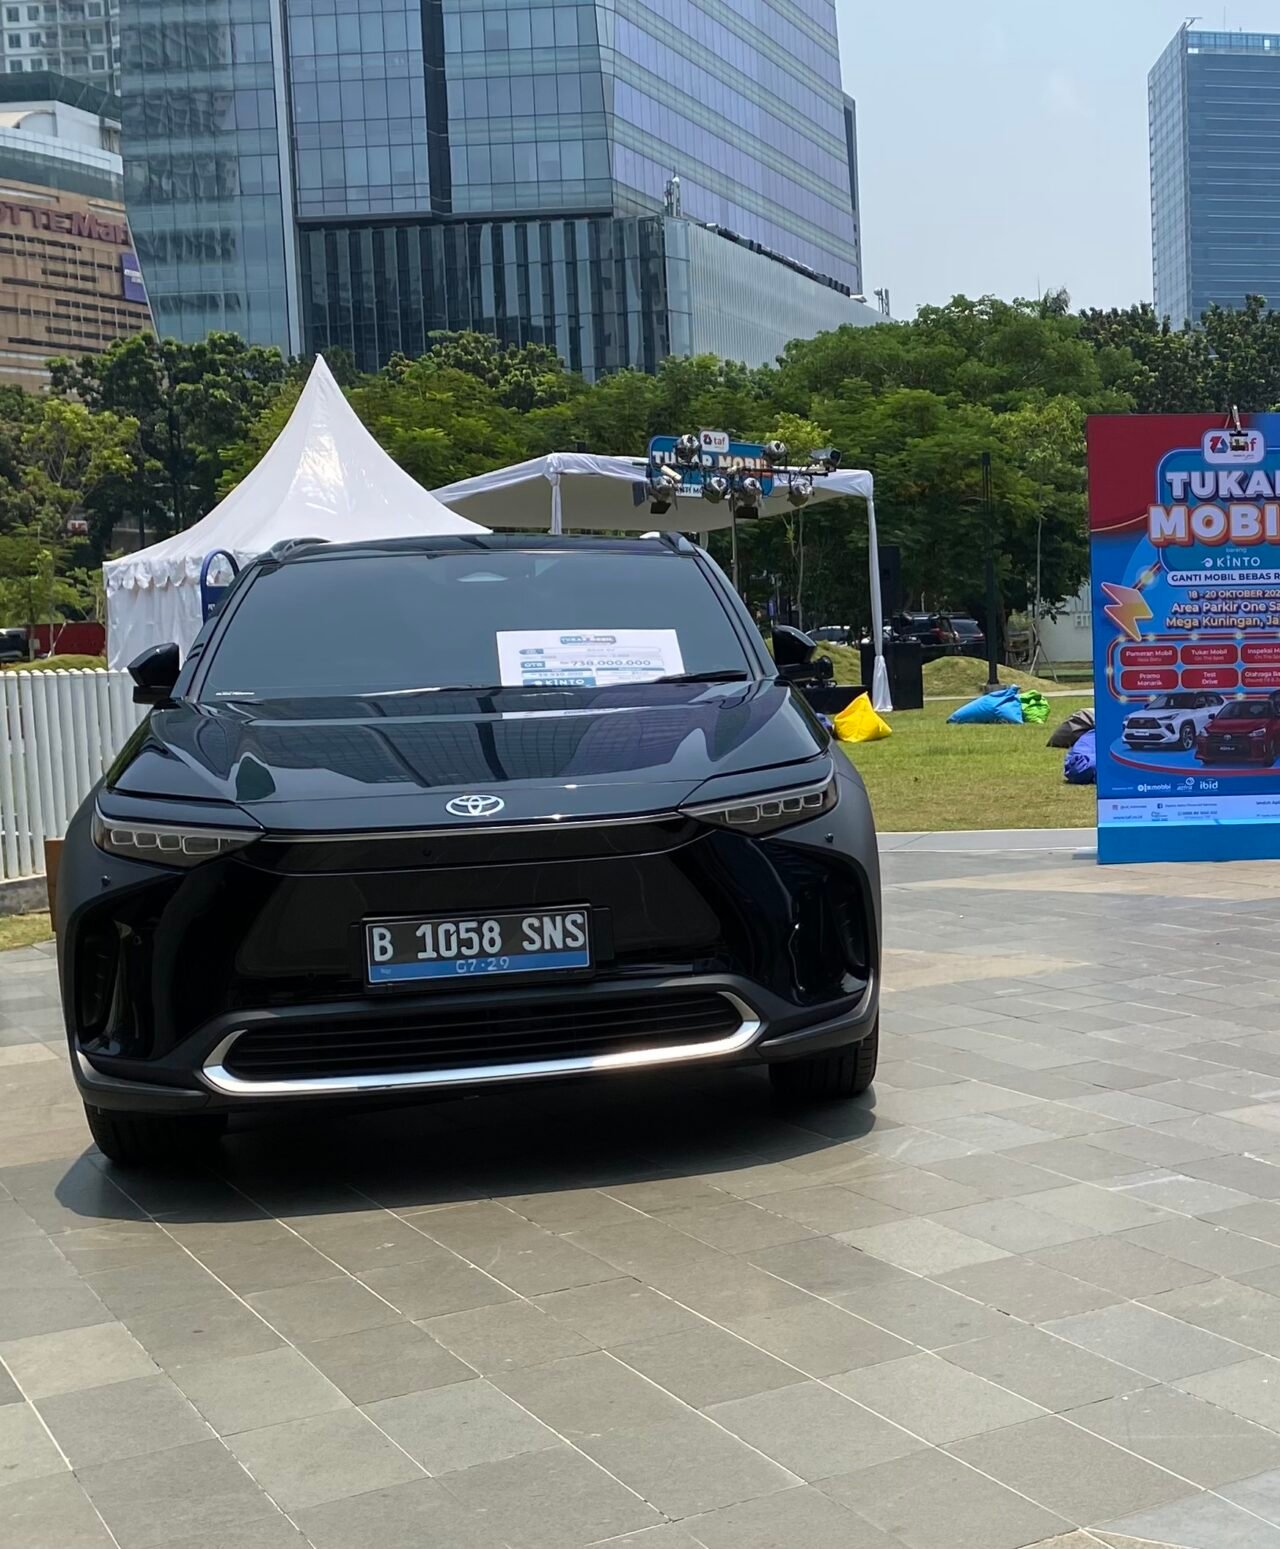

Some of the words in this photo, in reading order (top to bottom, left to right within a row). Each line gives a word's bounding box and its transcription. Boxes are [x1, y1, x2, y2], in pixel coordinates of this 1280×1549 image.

[714, 436, 725, 445] taf
[652, 450, 712, 467] TUAR
[1171, 573, 1202, 582] GANTI
[1204, 573, 1236, 581] MOBIL
[1239, 572, 1271, 581] BEBAS
[1188, 590, 1198, 599] 18
[1205, 590, 1216, 599] 20
[1218, 590, 1263, 599] OKTOBER
[1171, 602, 1199, 613] Area
[1202, 601, 1239, 612] Parkir
[1241, 601, 1266, 612] One
[1166, 617, 1200, 629] Mega
[1202, 615, 1264, 628] Kuningan,
[545, 678, 585, 686] KINTO
[1199, 780, 1219, 790] ibid
[372, 927, 394, 962] B
[415, 920, 502, 959] 1058
[521, 913, 585, 951] SNS
